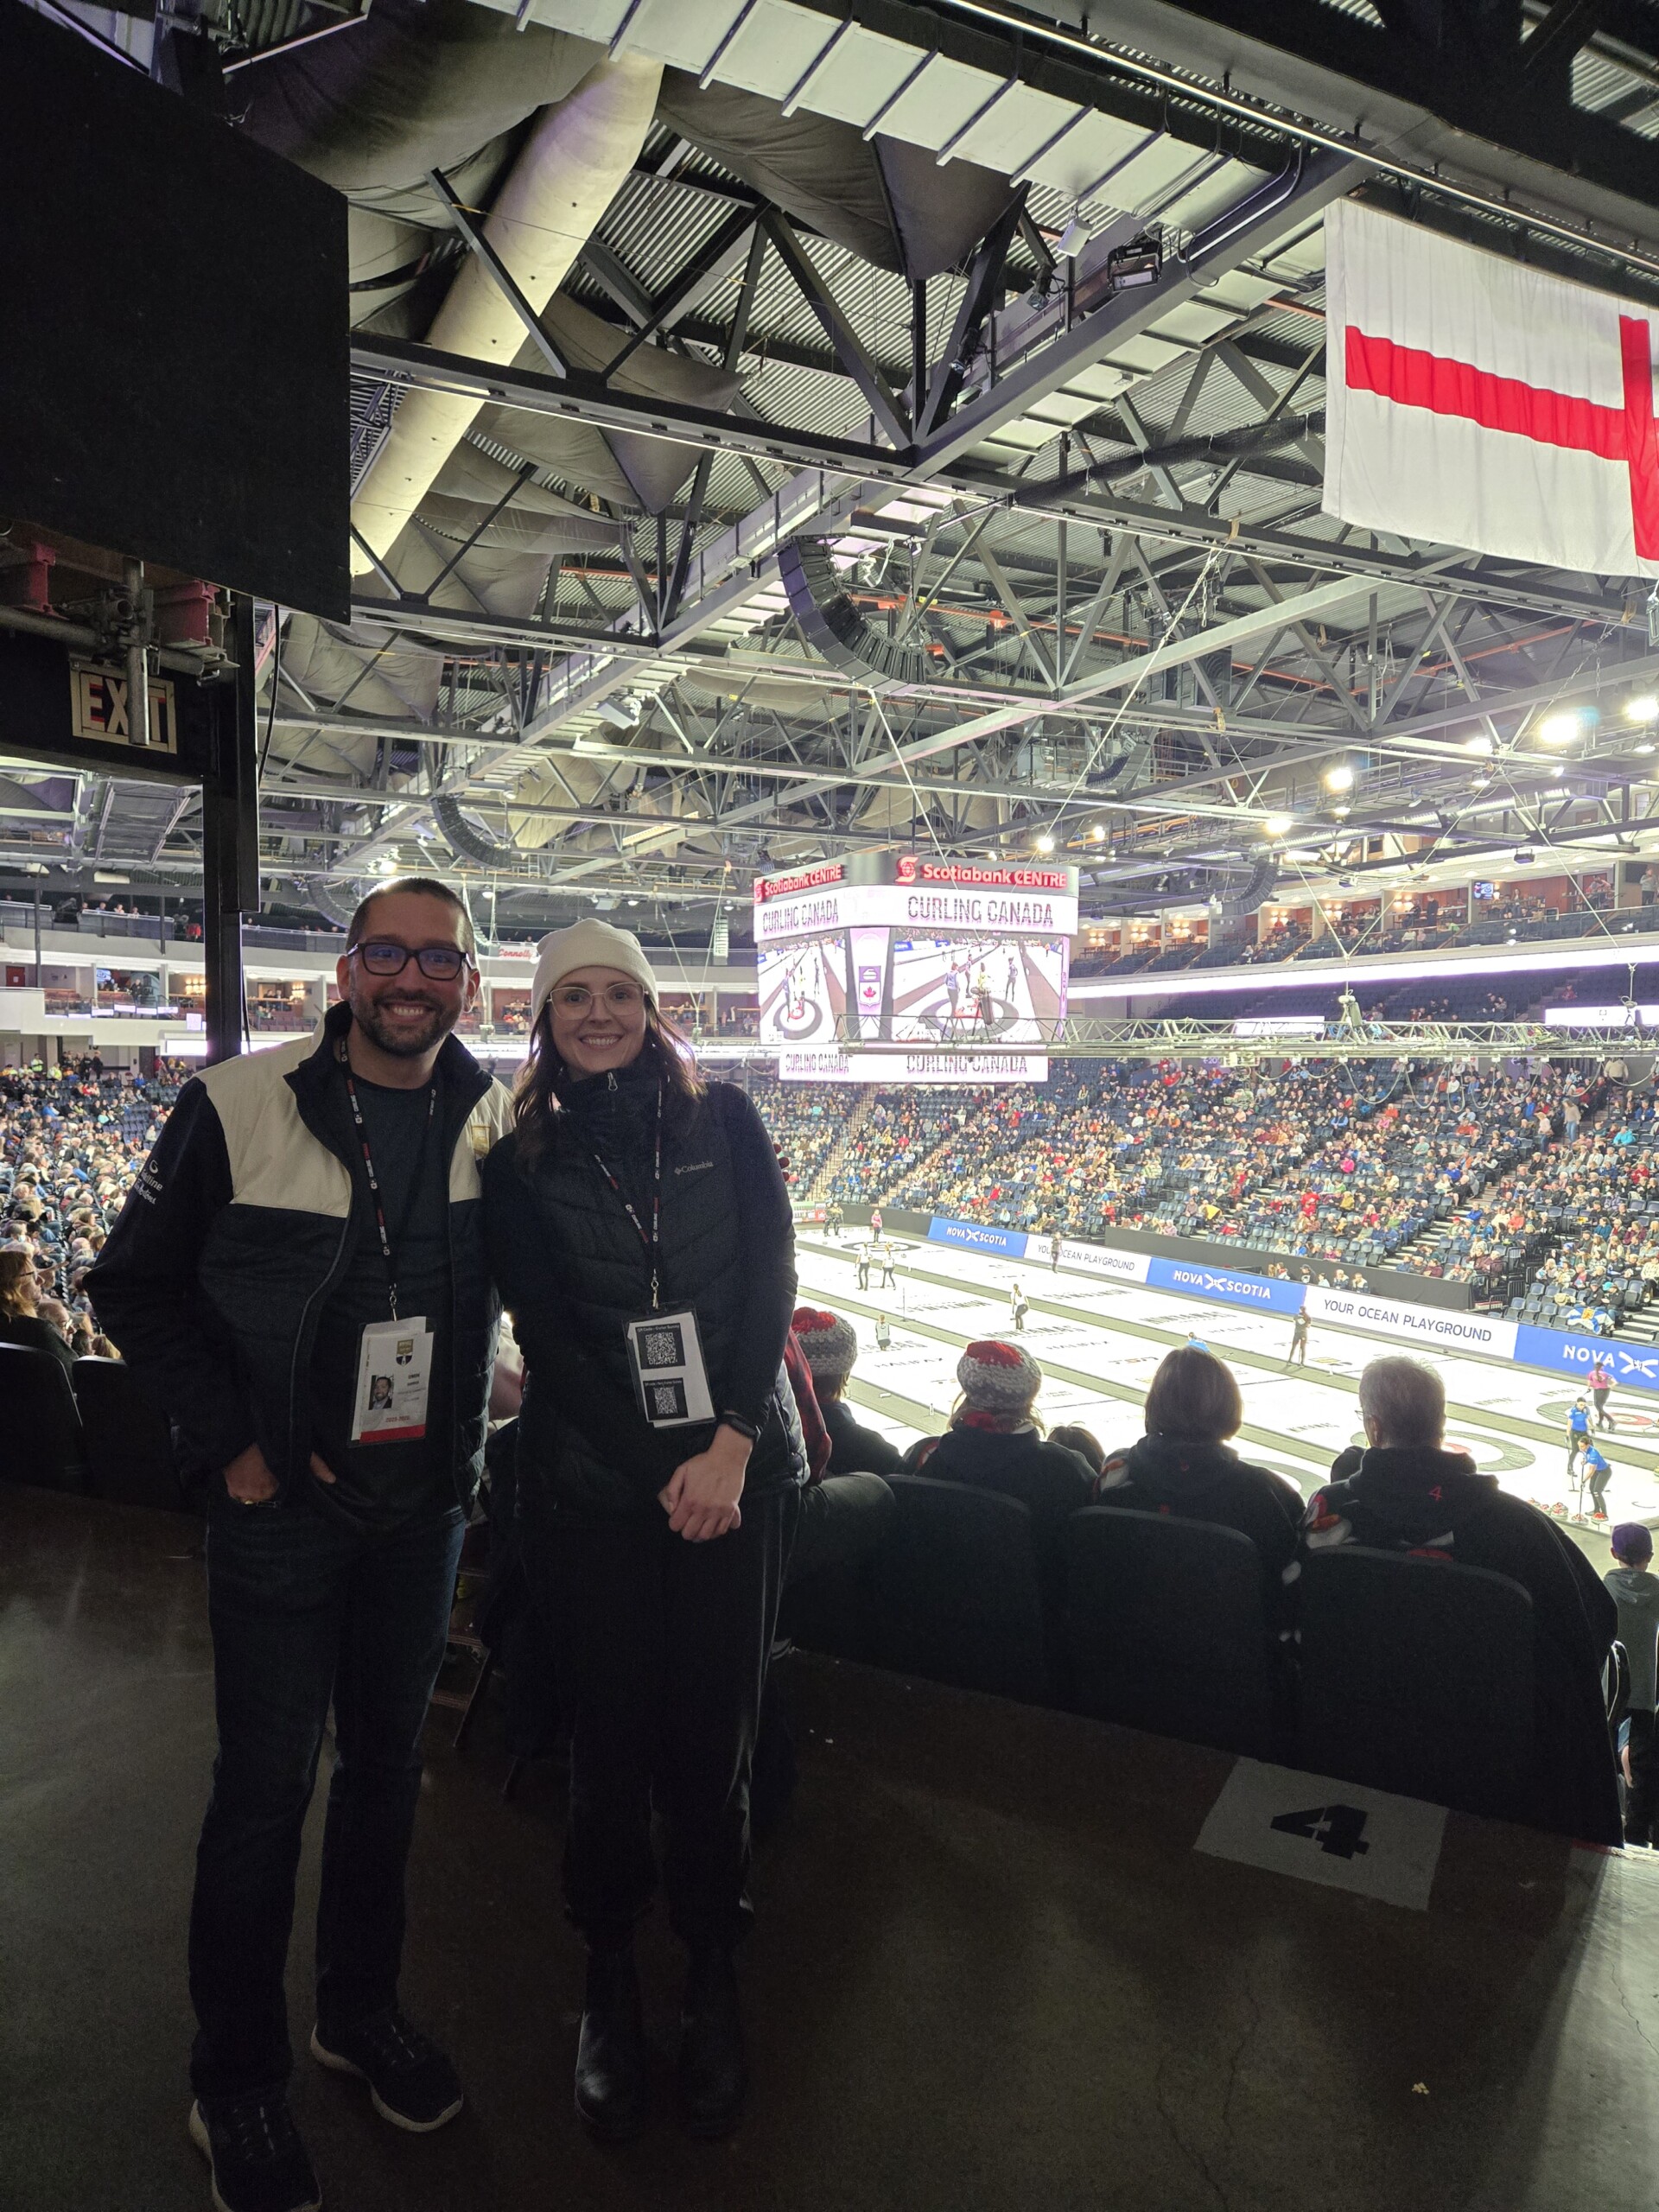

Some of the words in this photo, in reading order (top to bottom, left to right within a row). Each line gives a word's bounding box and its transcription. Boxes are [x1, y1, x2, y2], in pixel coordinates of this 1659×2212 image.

[80, 672, 168, 742] EXT
[765, 875, 810, 896] Scotiabank
[810, 863, 842, 887] CENTRE
[923, 862, 1011, 885] Scotiabank
[1014, 868, 1068, 888] CENTRE
[762, 906, 799, 932] CURLING
[801, 897, 839, 925] CANADA
[907, 895, 982, 922] CURLING
[988, 900, 1054, 925] CANADA
[785, 1053, 817, 1073] CURLING
[818, 1052, 849, 1073] CANADA
[906, 1055, 969, 1073] CURLING
[973, 1056, 1028, 1072] CANADA
[681, 1160, 715, 1174] Columbia
[946, 1225, 965, 1239] NOVA
[979, 1232, 1007, 1247] SCOTIA
[1084, 1253, 1135, 1271] PLAYGROUND
[1174, 1269, 1204, 1287] NOVA
[1227, 1280, 1271, 1300] SCOTIA
[1324, 1299, 1354, 1316] YOUR
[1357, 1305, 1399, 1325] OCEAN
[1403, 1313, 1492, 1343] PLAYGROUND
[1562, 1344, 1615, 1368] NOVA
[1428, 1486, 1442, 1501] 4
[1270, 1803, 1370, 1859] 4
